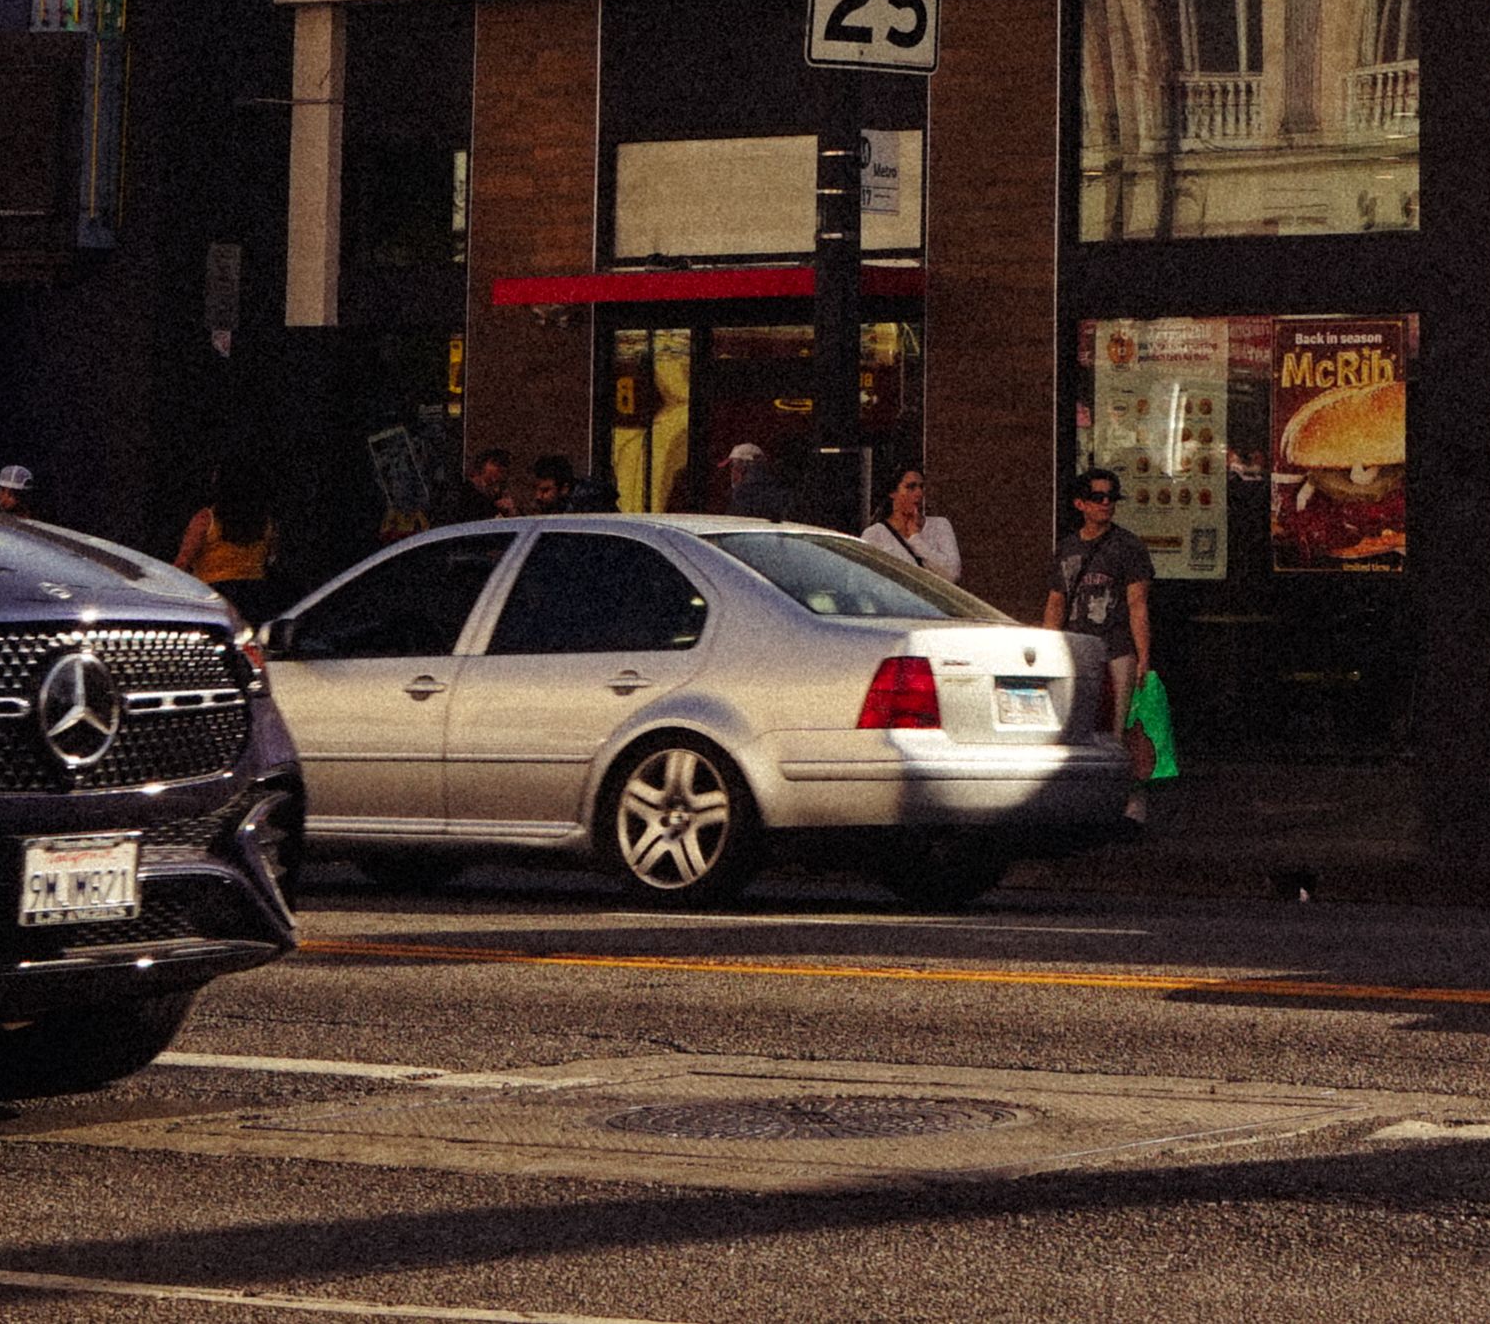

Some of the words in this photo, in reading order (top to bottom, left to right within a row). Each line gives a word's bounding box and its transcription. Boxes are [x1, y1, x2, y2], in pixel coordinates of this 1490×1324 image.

[1294, 332, 1324, 345] Back
[1326, 332, 1338, 344] in
[1340, 334, 1383, 344] season
[1281, 346, 1395, 389] McRib
